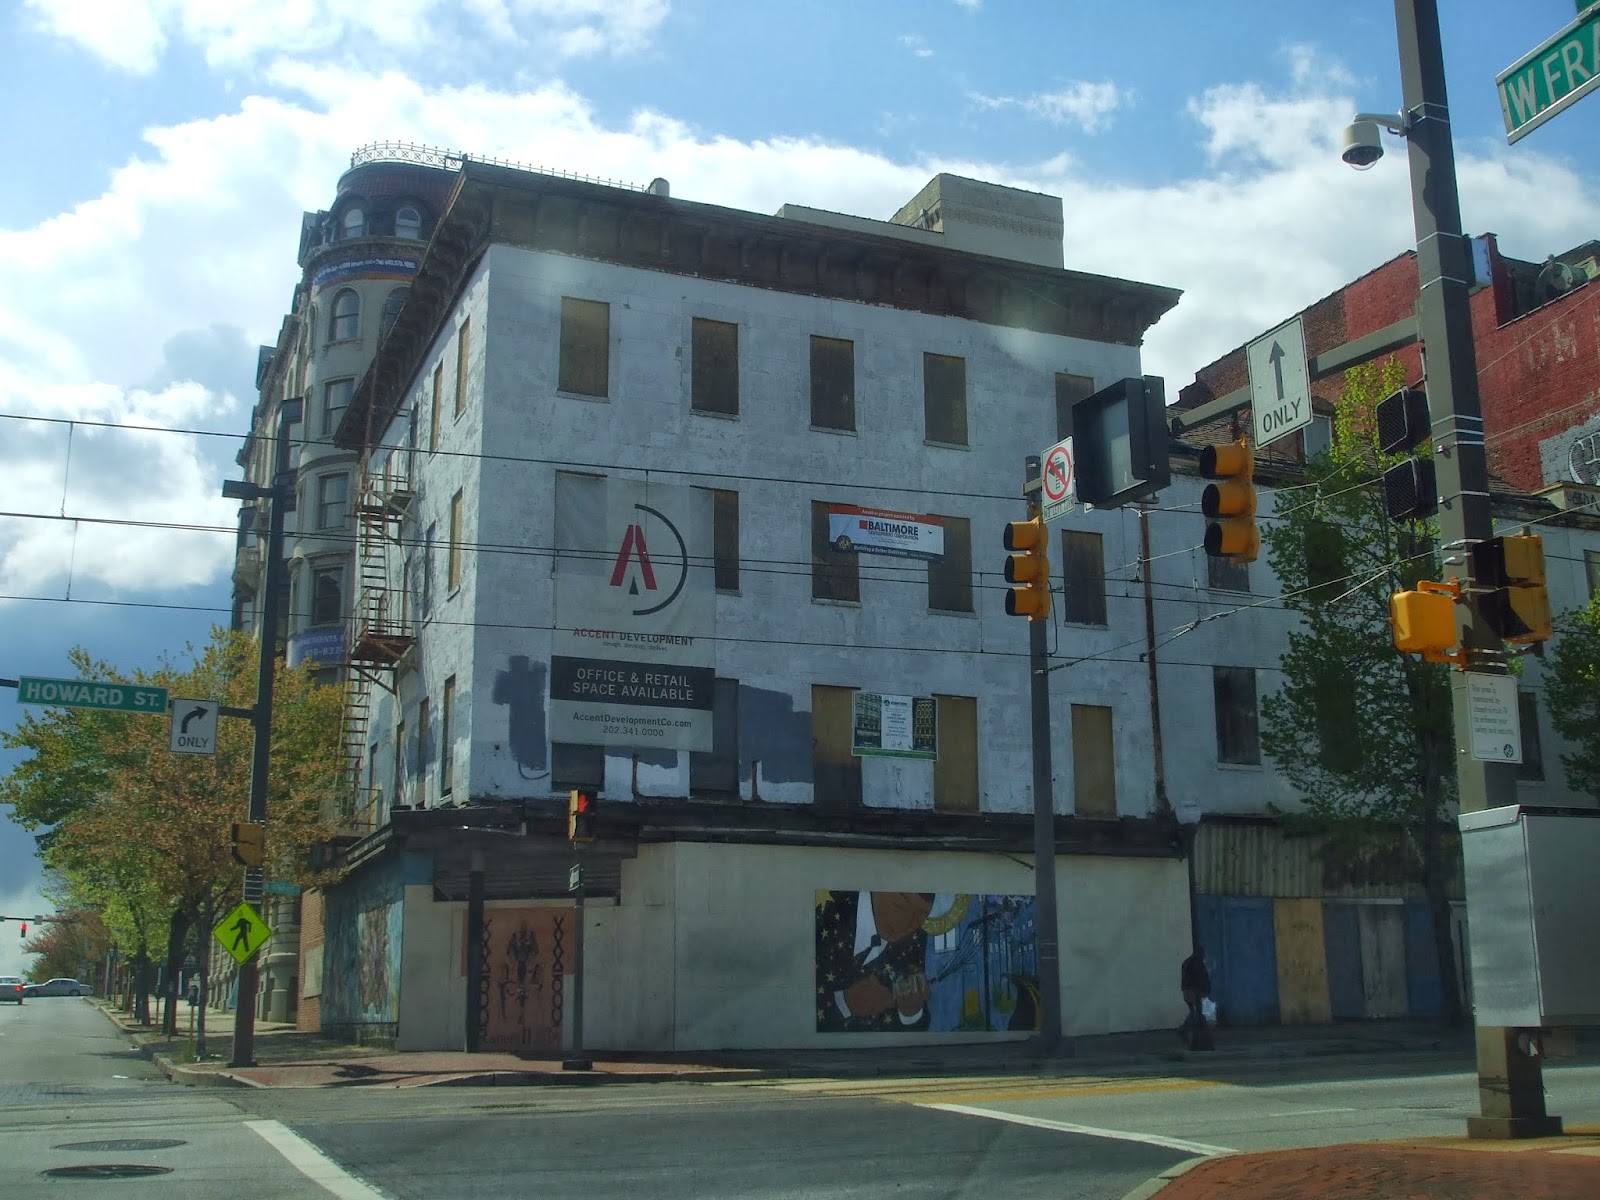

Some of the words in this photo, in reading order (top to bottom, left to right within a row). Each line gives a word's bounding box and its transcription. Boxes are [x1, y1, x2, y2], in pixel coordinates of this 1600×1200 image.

[1263, 398, 1301, 433] ONLY
[868, 521, 918, 536] BALTIMORE
[894, 533, 918, 541] CORPORATION
[573, 627, 617, 640] ACCENT
[620, 632, 694, 646] DEVELOPMENT
[577, 668, 625, 683] OFFICE
[631, 673, 639, 684] &
[645, 674, 690, 687] RETAIL
[26, 682, 123, 706] HOWARD
[134, 691, 160, 707] ST.
[573, 682, 615, 696] SPACE
[621, 685, 694, 701] AVAILABLE
[573, 712, 692, 728] AccentDevelopmentCo.com
[603, 726, 664, 737] 202.341.0000
[178, 737, 208, 749] ONLY
